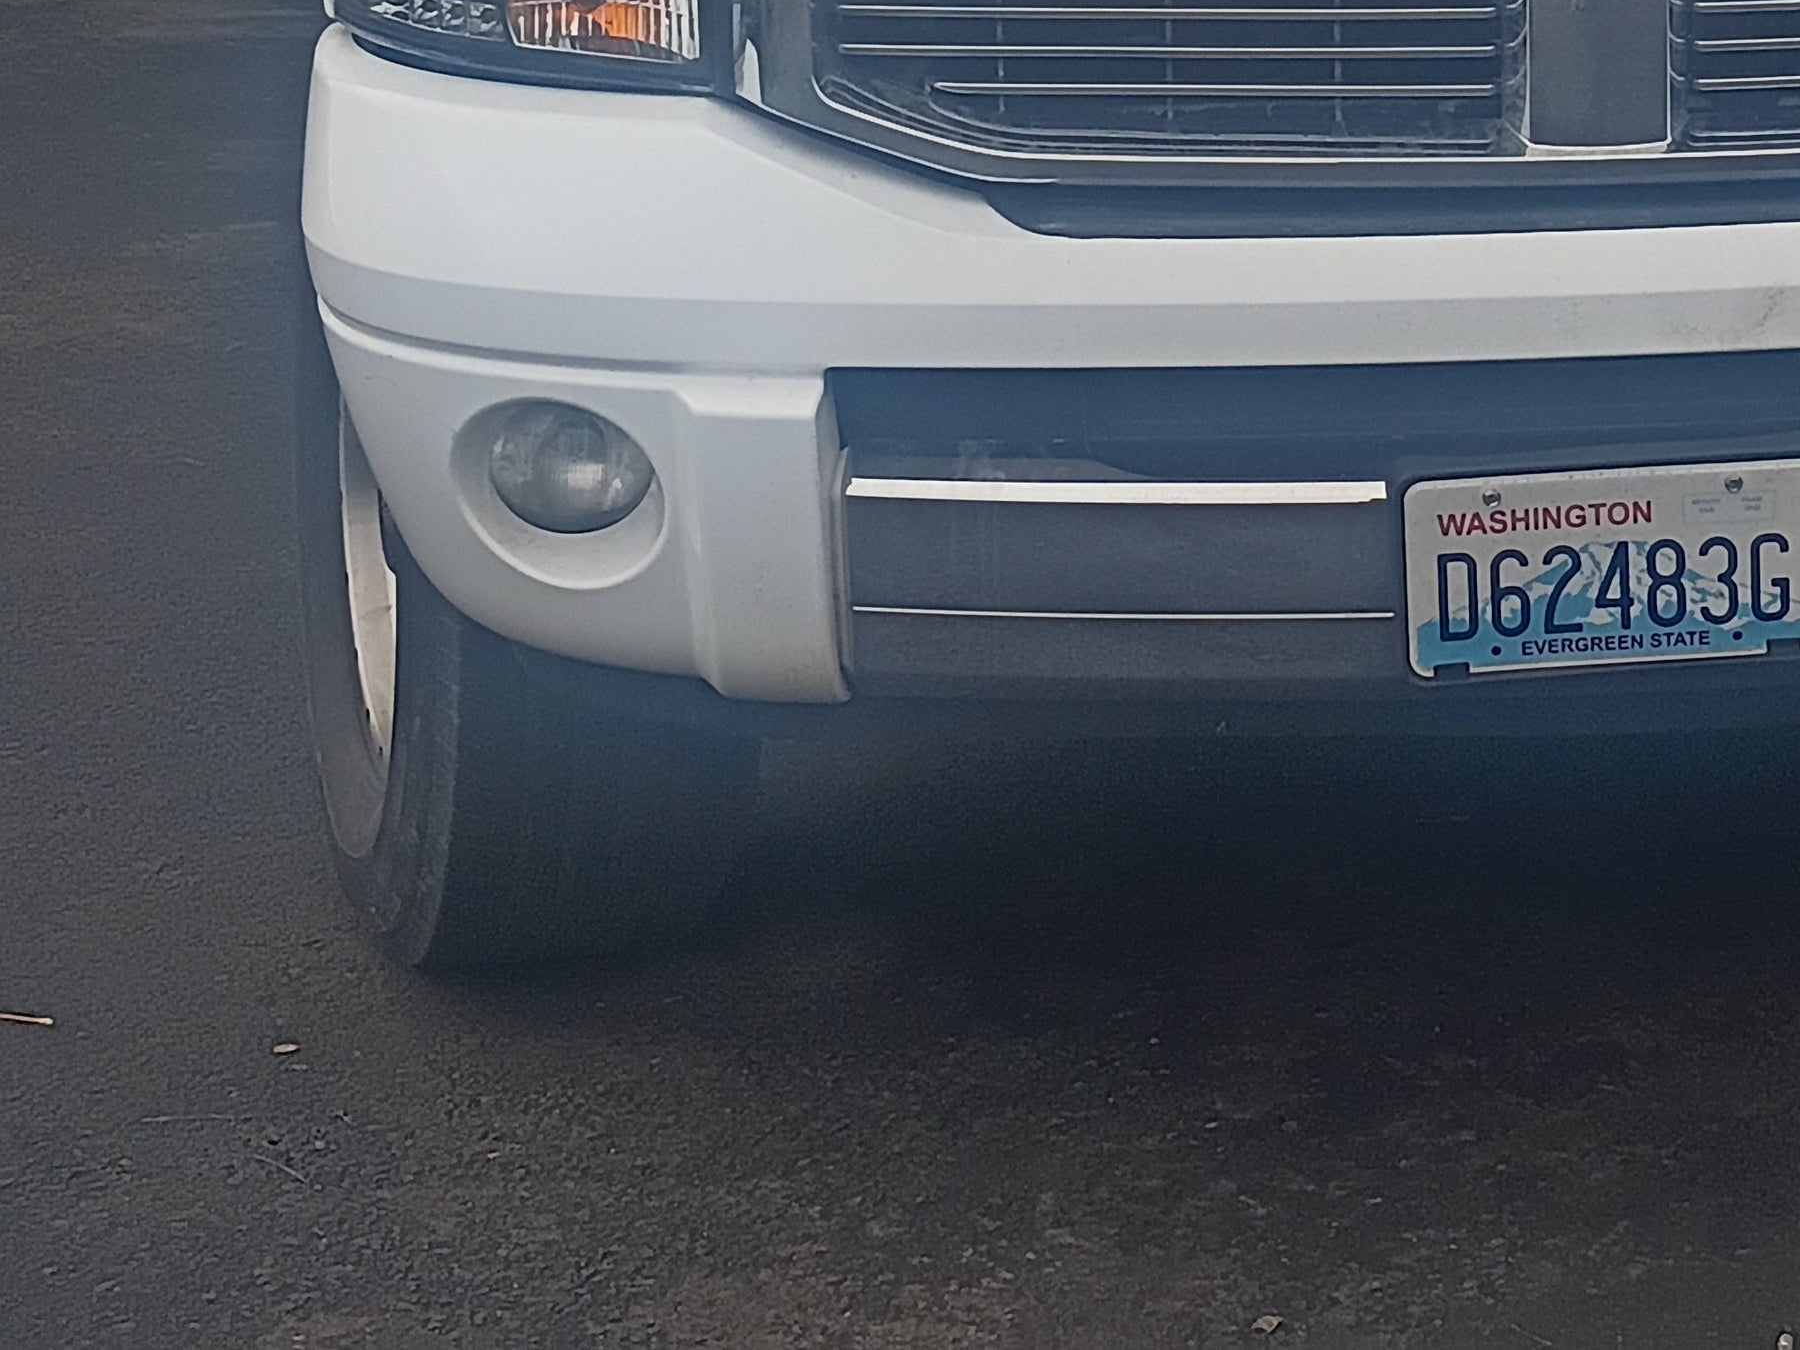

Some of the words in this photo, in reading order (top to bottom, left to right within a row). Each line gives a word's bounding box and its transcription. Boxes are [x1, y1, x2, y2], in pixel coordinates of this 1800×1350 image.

[1437, 501, 1652, 536] WASHINGTON
[1437, 533, 1790, 642] D62483G
[1521, 634, 1644, 656] EVERGREEN
[1650, 631, 1710, 648] STATE
